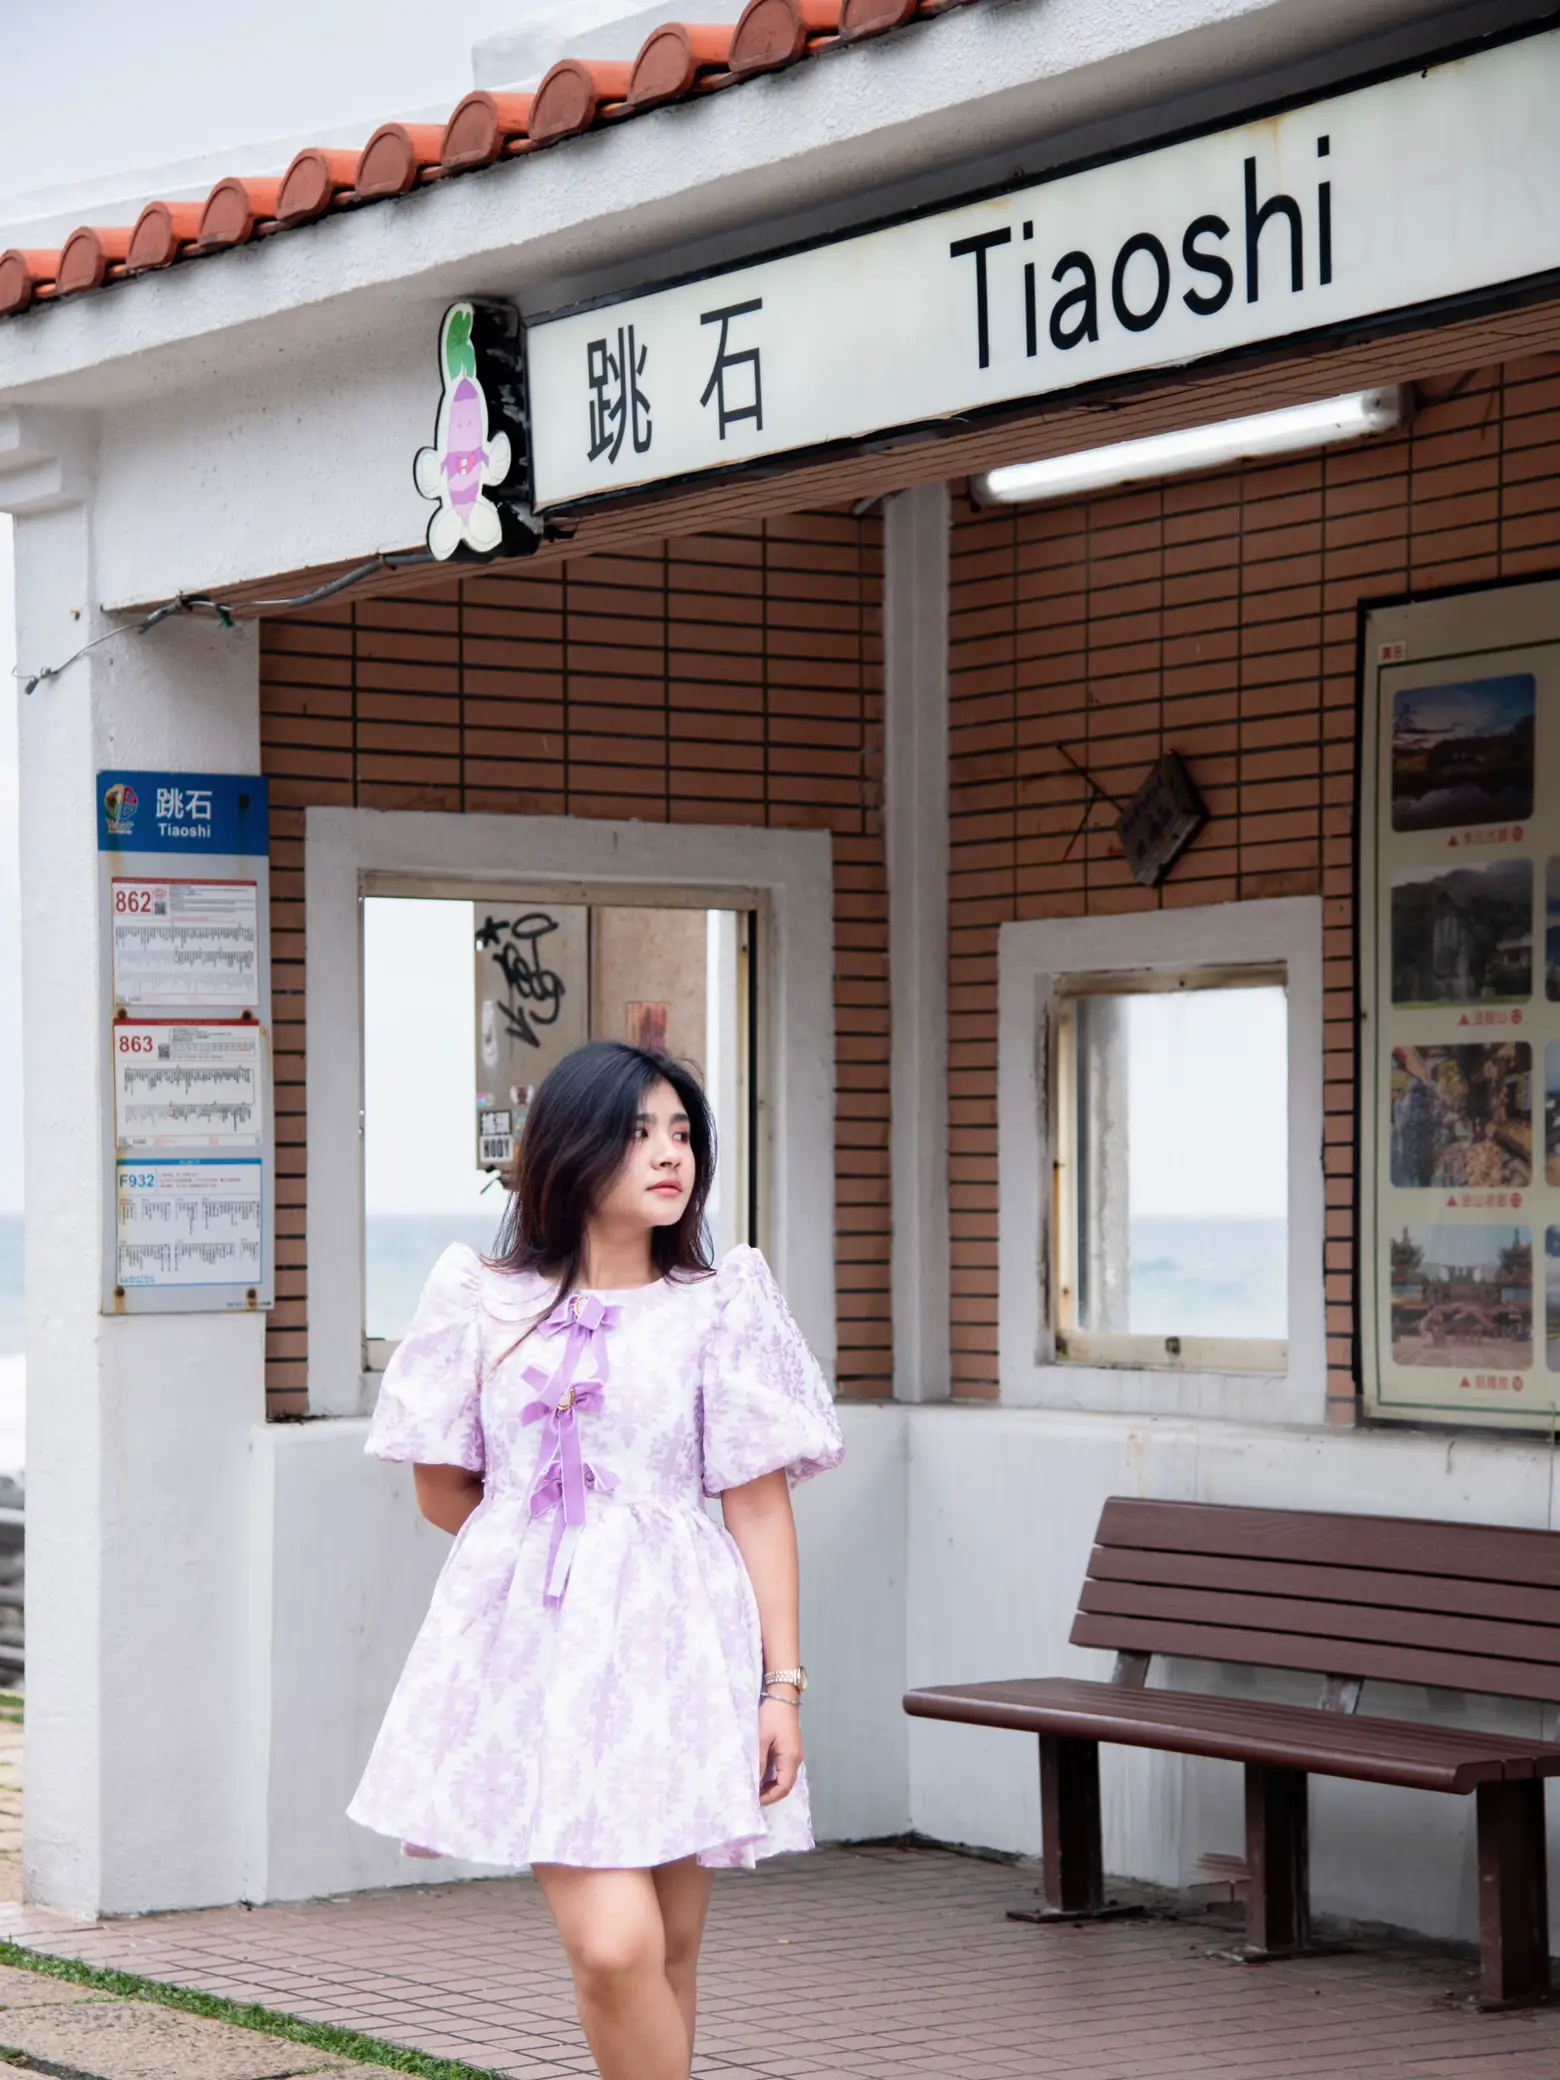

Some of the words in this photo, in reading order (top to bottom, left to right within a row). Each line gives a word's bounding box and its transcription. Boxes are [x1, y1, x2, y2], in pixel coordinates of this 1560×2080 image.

[587, 297, 763, 465] 跳石
[949, 134, 1332, 369] Tiaoshi
[155, 788, 212, 820] 跳石
[158, 822, 211, 838] Tiaoshi
[115, 891, 151, 913] 862
[118, 1036, 153, 1053] 863
[119, 1174, 155, 1188] F932
